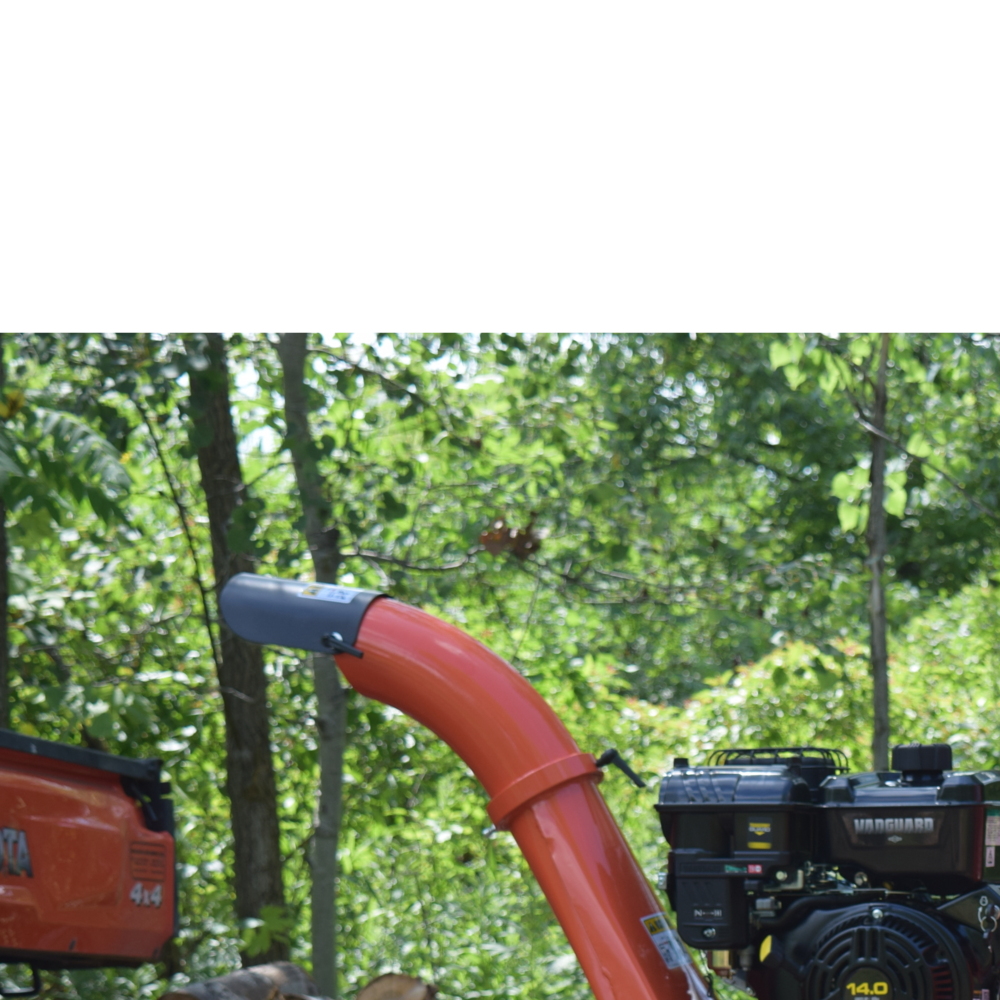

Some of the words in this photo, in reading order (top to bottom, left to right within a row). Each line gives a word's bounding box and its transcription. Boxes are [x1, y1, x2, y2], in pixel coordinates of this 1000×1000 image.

[854, 817, 934, 834] VANGUARD
[0, 826, 34, 878] TA
[130, 883, 162, 907] 4x4
[846, 982, 888, 996] 14.0
